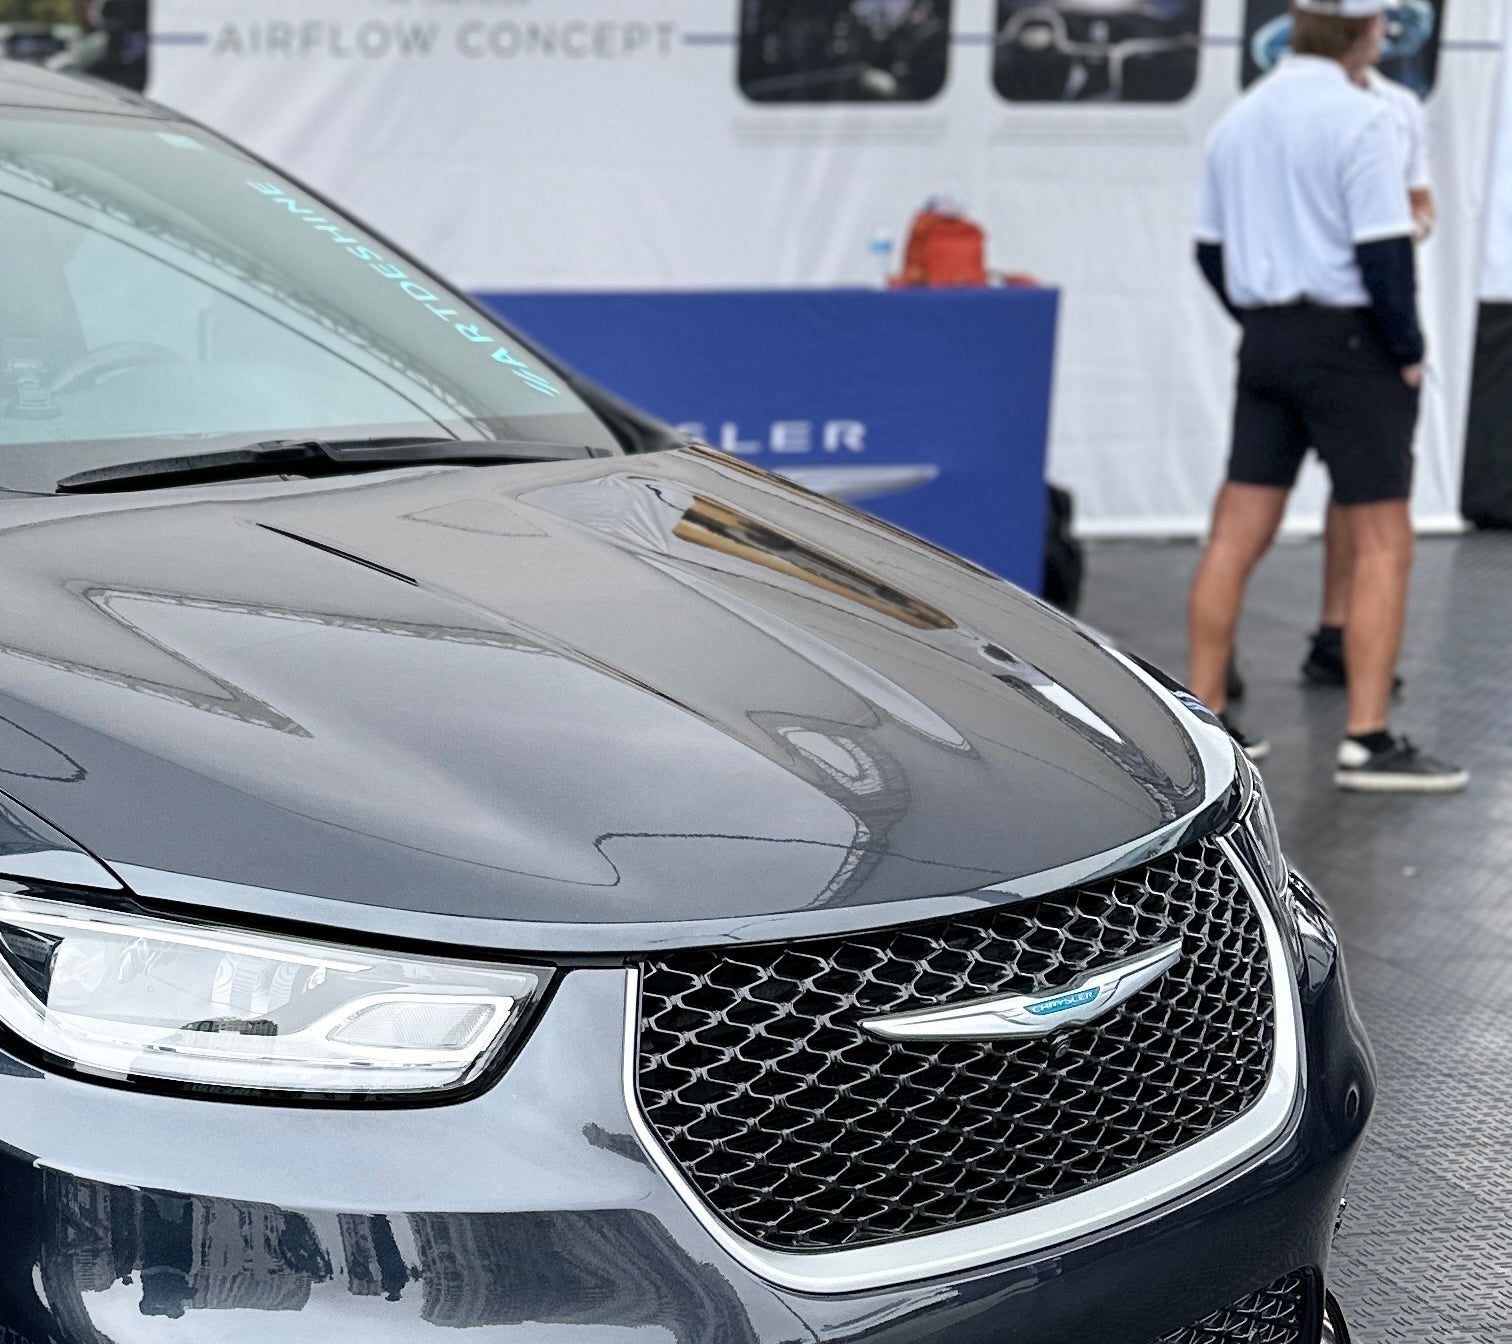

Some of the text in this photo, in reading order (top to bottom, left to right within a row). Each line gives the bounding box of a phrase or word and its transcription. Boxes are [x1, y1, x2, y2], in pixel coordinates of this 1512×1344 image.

[212, 21, 678, 60] AIRFLOW CONCEPT
[246, 180, 529, 369] ARTDESHINE
[1031, 991, 1094, 1013] CHRYSLER
